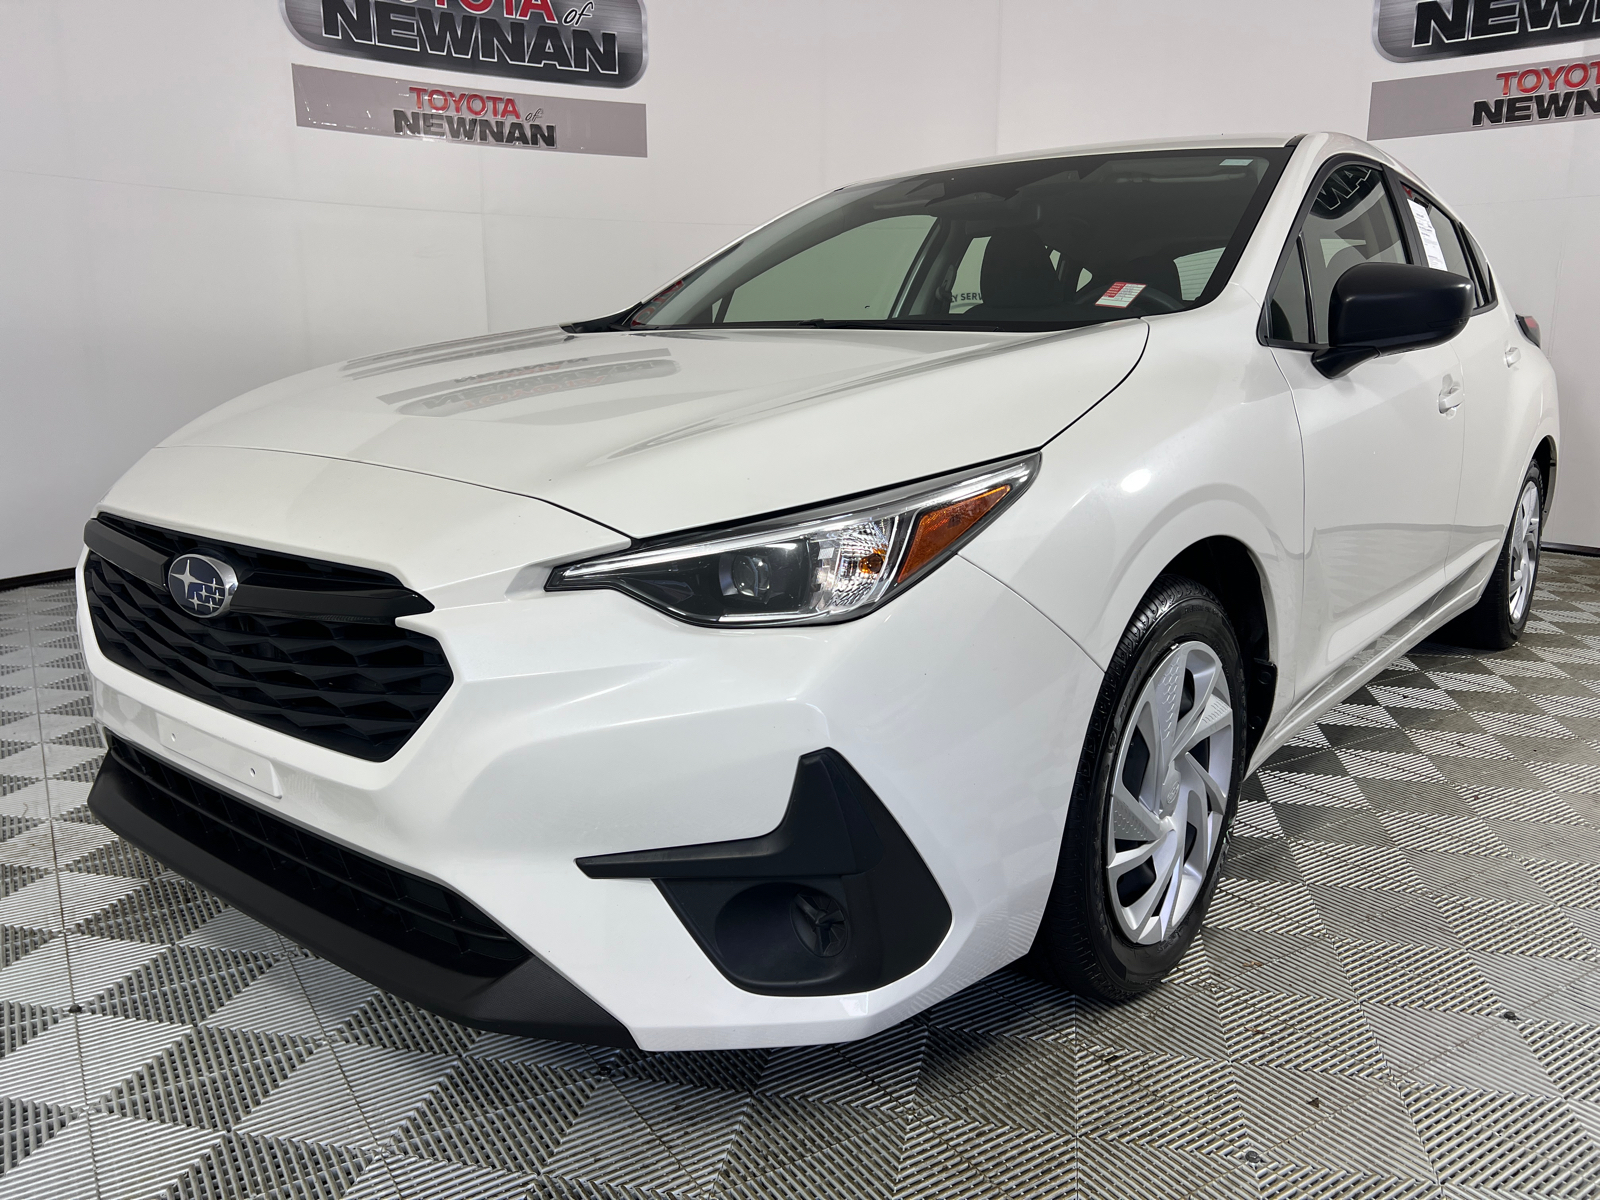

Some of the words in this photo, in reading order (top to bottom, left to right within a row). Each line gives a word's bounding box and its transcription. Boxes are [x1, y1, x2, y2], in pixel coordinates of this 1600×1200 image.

[562, 1, 595, 26] of
[1411, 0, 1600, 48] NEW
[321, 0, 619, 75] NEWNAN
[408, 86, 522, 120] TOYOTA
[525, 107, 543, 123] of
[393, 109, 557, 149] NEWNAN
